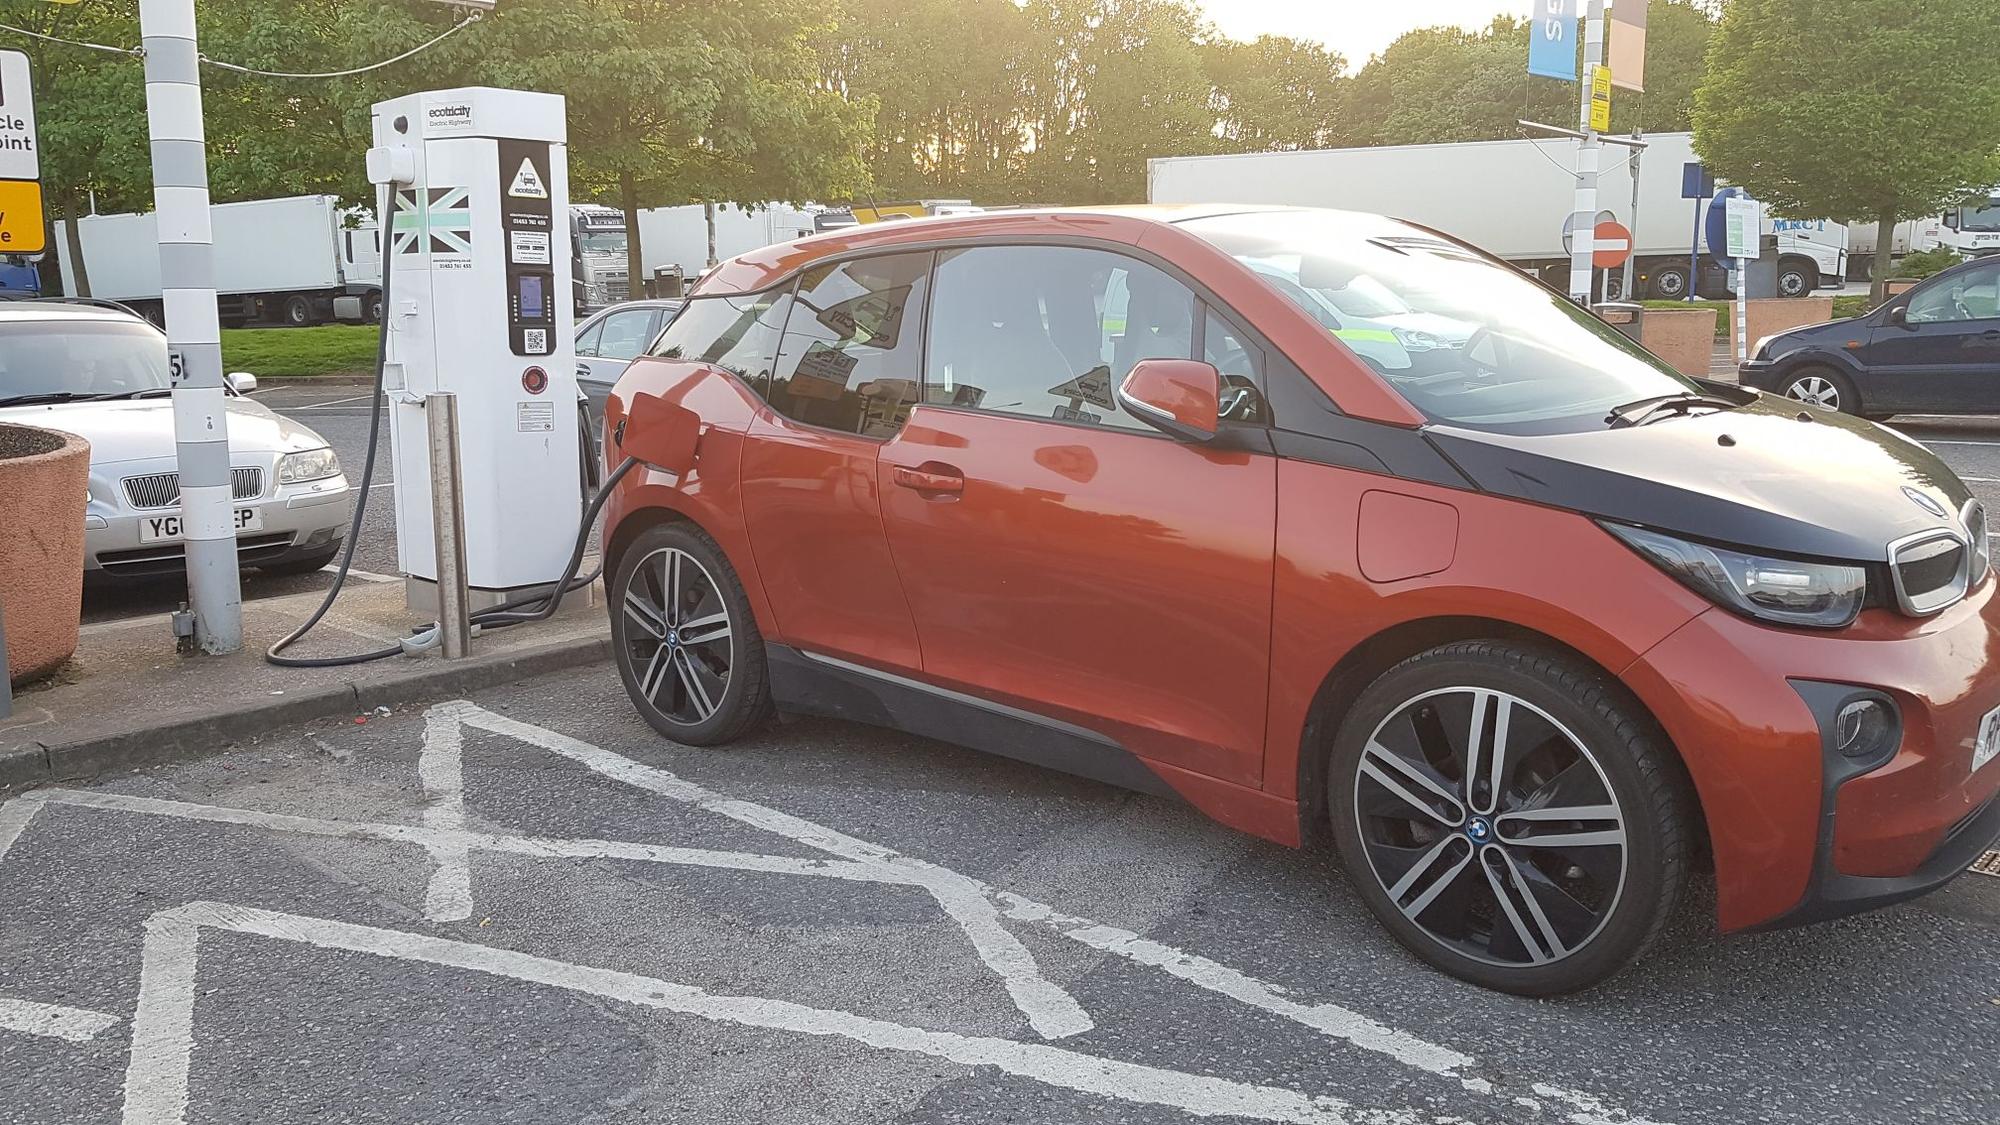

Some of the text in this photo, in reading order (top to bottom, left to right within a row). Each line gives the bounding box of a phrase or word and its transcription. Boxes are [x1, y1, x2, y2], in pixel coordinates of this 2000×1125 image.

[429, 105, 471, 117] ecotricity
[514, 187, 542, 196] ecotricity
[150, 517, 184, 537] YG
